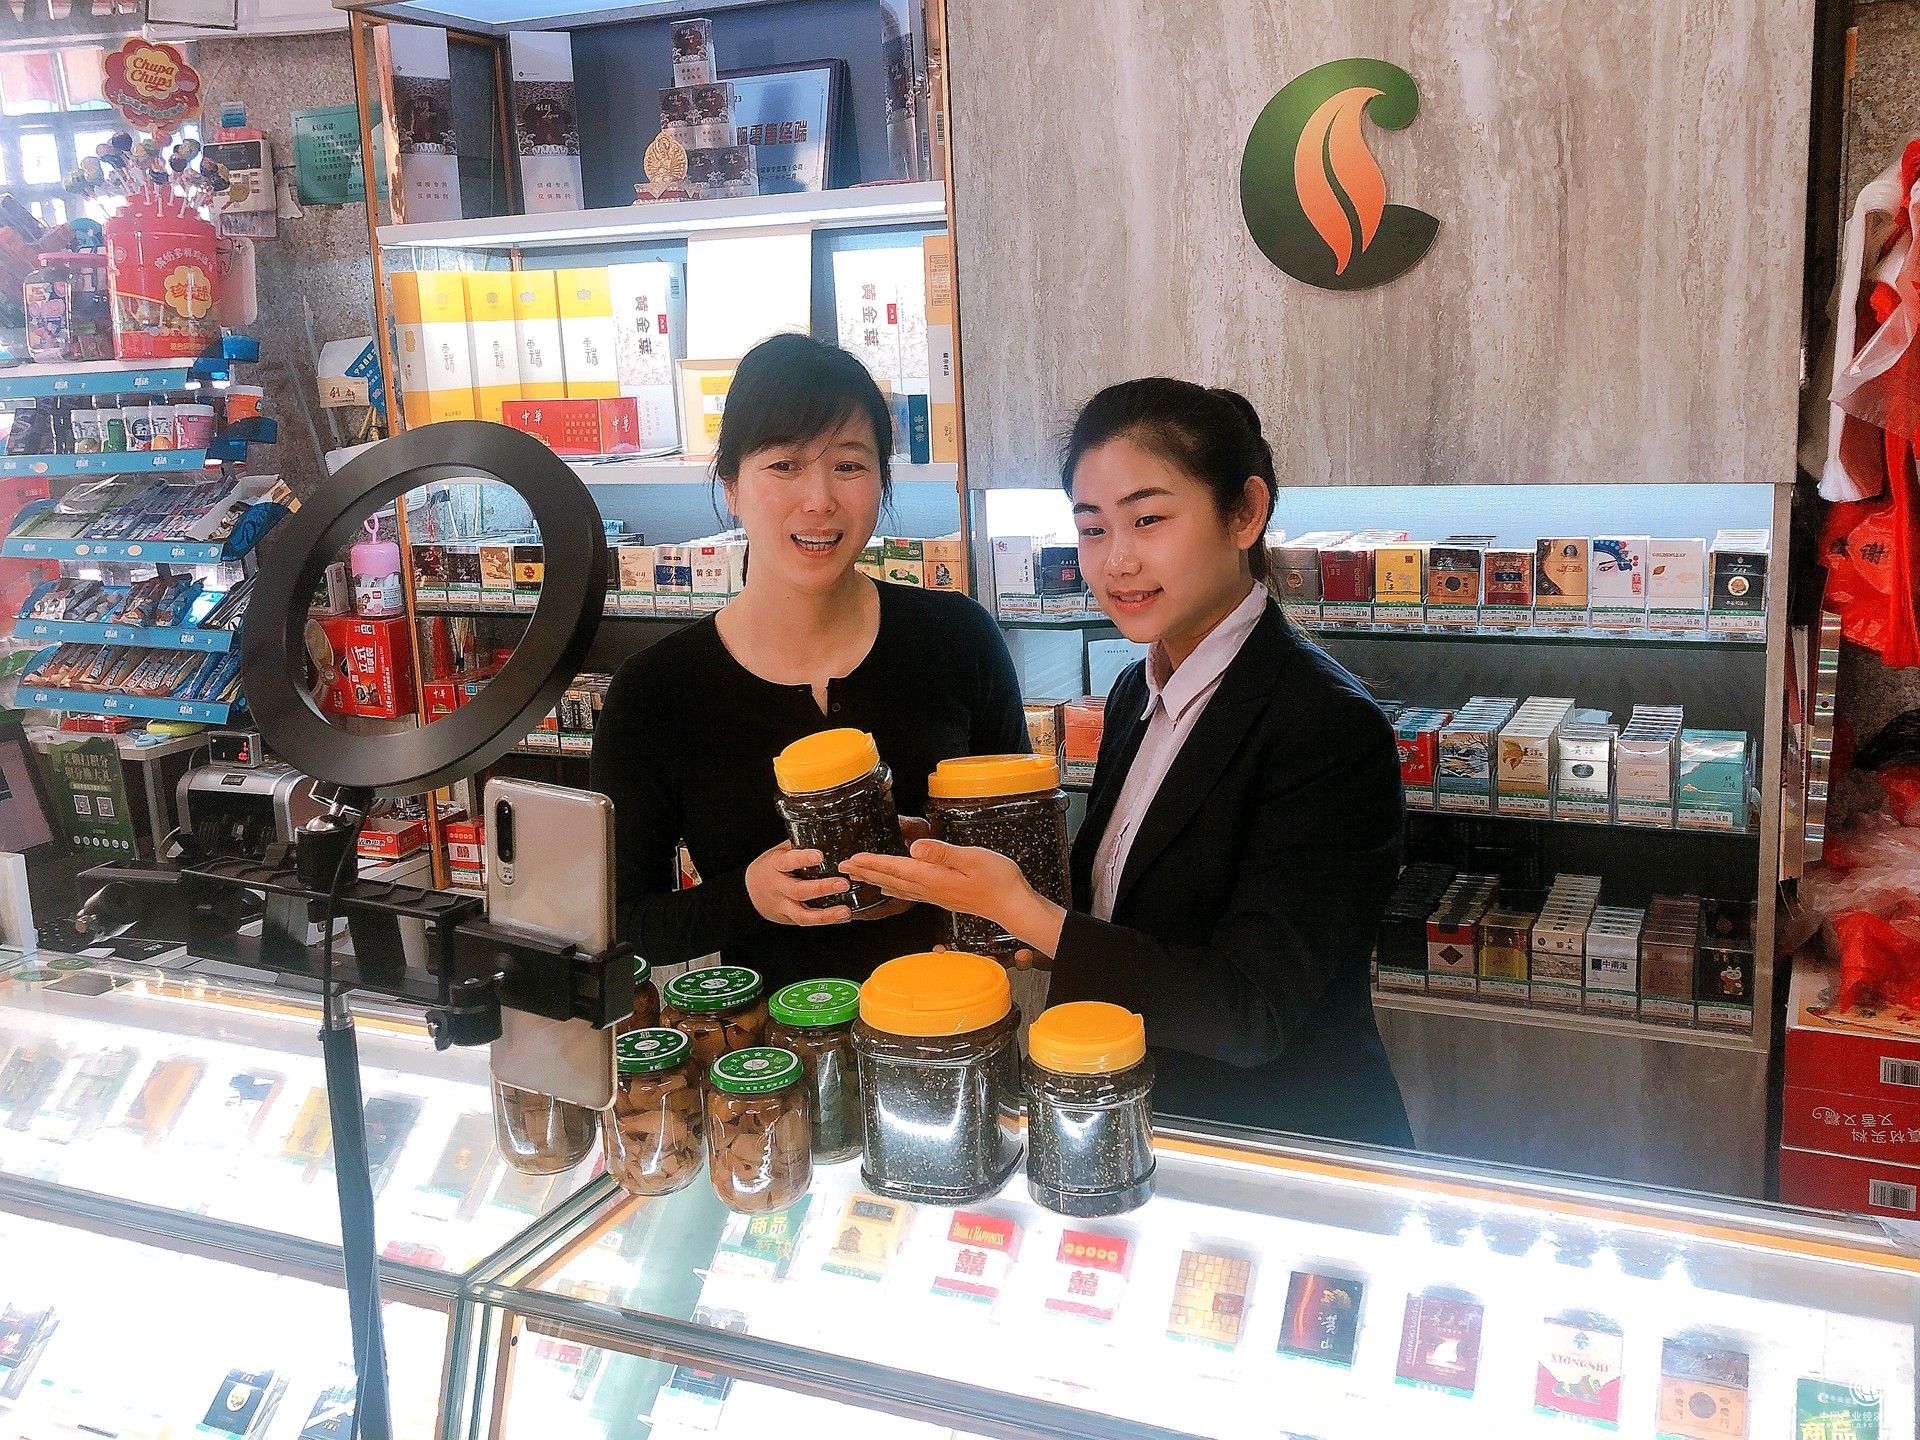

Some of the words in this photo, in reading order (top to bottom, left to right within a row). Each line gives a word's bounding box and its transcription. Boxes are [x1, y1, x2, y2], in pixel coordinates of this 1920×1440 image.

[132, 57, 174, 76] Chupa
[130, 69, 172, 92] Chups
[1602, 959, 1628, 971] 中南海
[1823, 1109, 1894, 1128] 又香又糯
[751, 1215, 788, 1236] 商品
[1551, 1353, 1610, 1373] XIONGSHI
